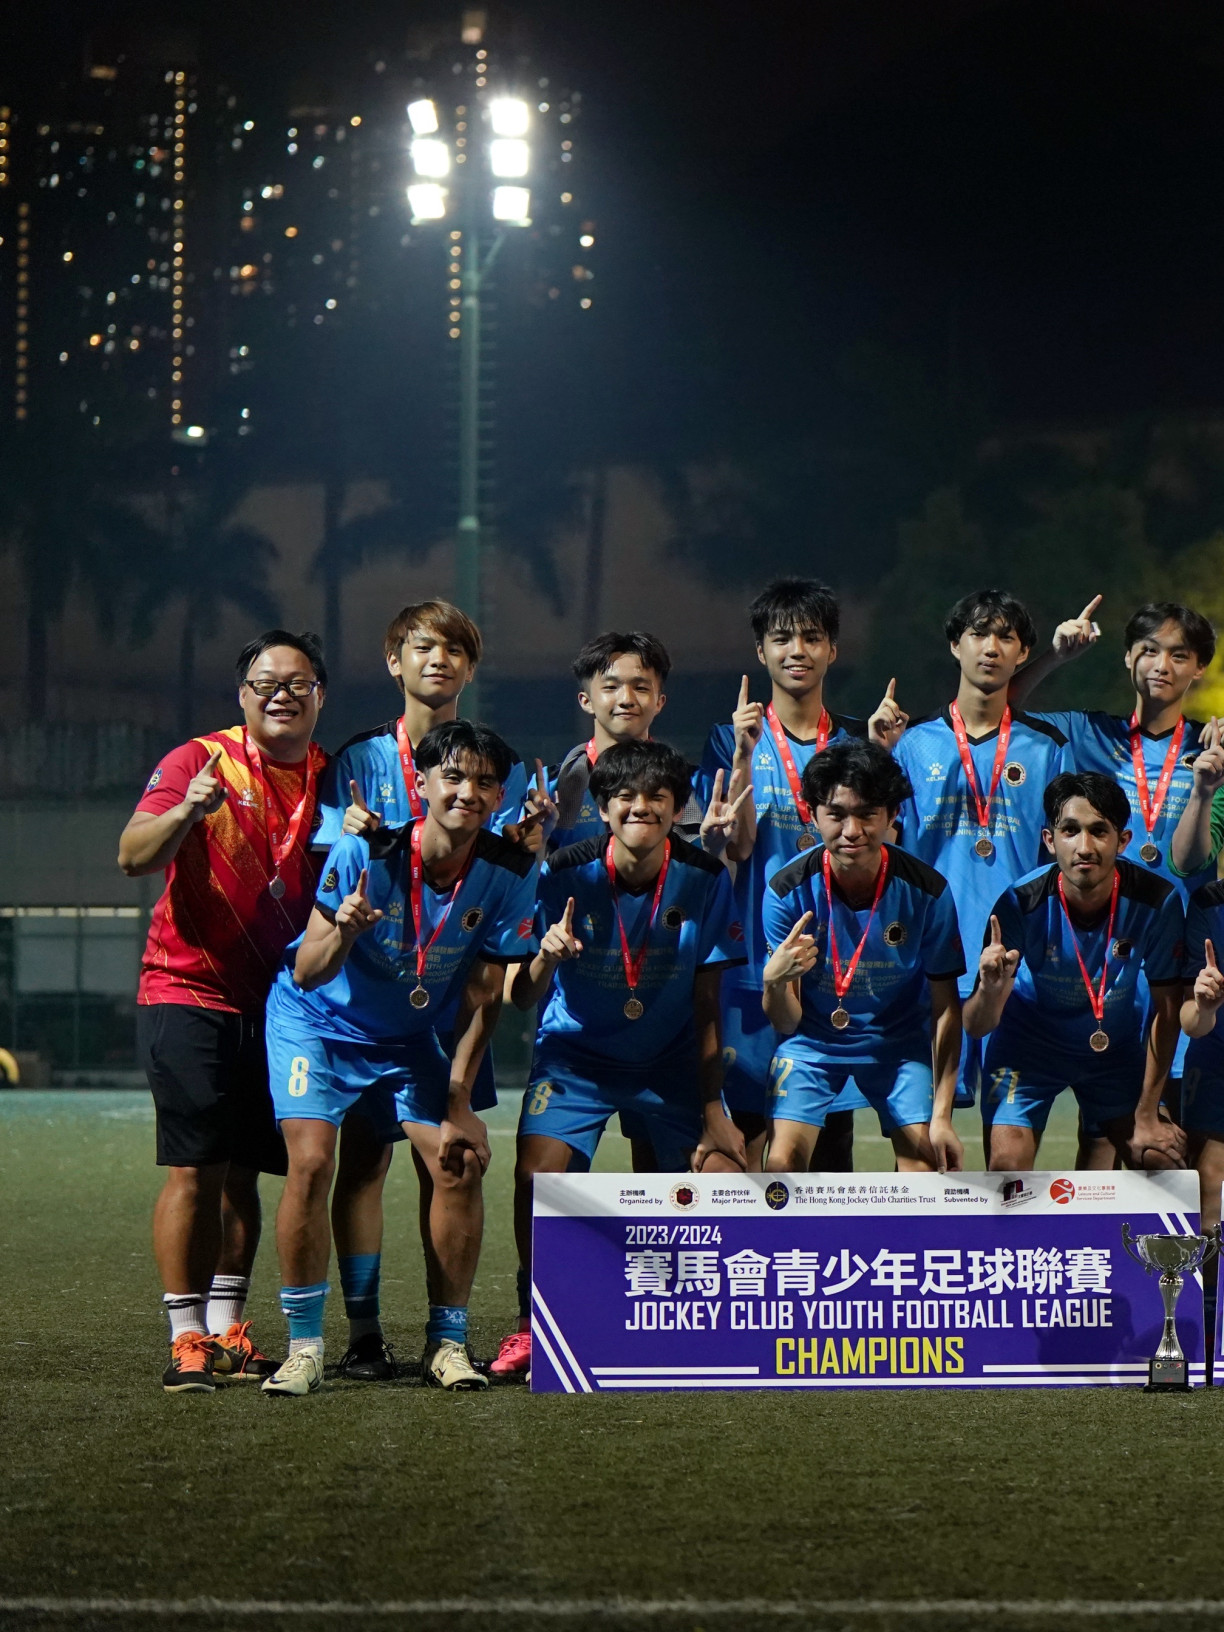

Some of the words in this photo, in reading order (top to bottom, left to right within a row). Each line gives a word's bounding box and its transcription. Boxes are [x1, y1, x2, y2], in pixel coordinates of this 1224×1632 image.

[288, 1056, 309, 1098] 8
[528, 1082, 553, 1115] 8
[620, 1197, 653, 1205] Organized
[654, 1197, 663, 1205] by
[794, 1186, 910, 1194] 香港賽馬會慈善信託基金
[809, 1196, 827, 1205] Hong
[829, 1196, 845, 1205] Kong
[846, 1196, 869, 1205] Jockey
[625, 1226, 722, 1245] 2023/2024
[624, 1247, 1112, 1297] 賽馬會青少年足球聯賽
[625, 1301, 722, 1330] JOCKEY
[731, 1301, 793, 1330] CLUB
[802, 1300, 883, 1329] YOUTH
[893, 1299, 1014, 1329] FOOTBALL
[1022, 1298, 1112, 1328] LEAGUE
[775, 1336, 964, 1375] CHAMPIONS
